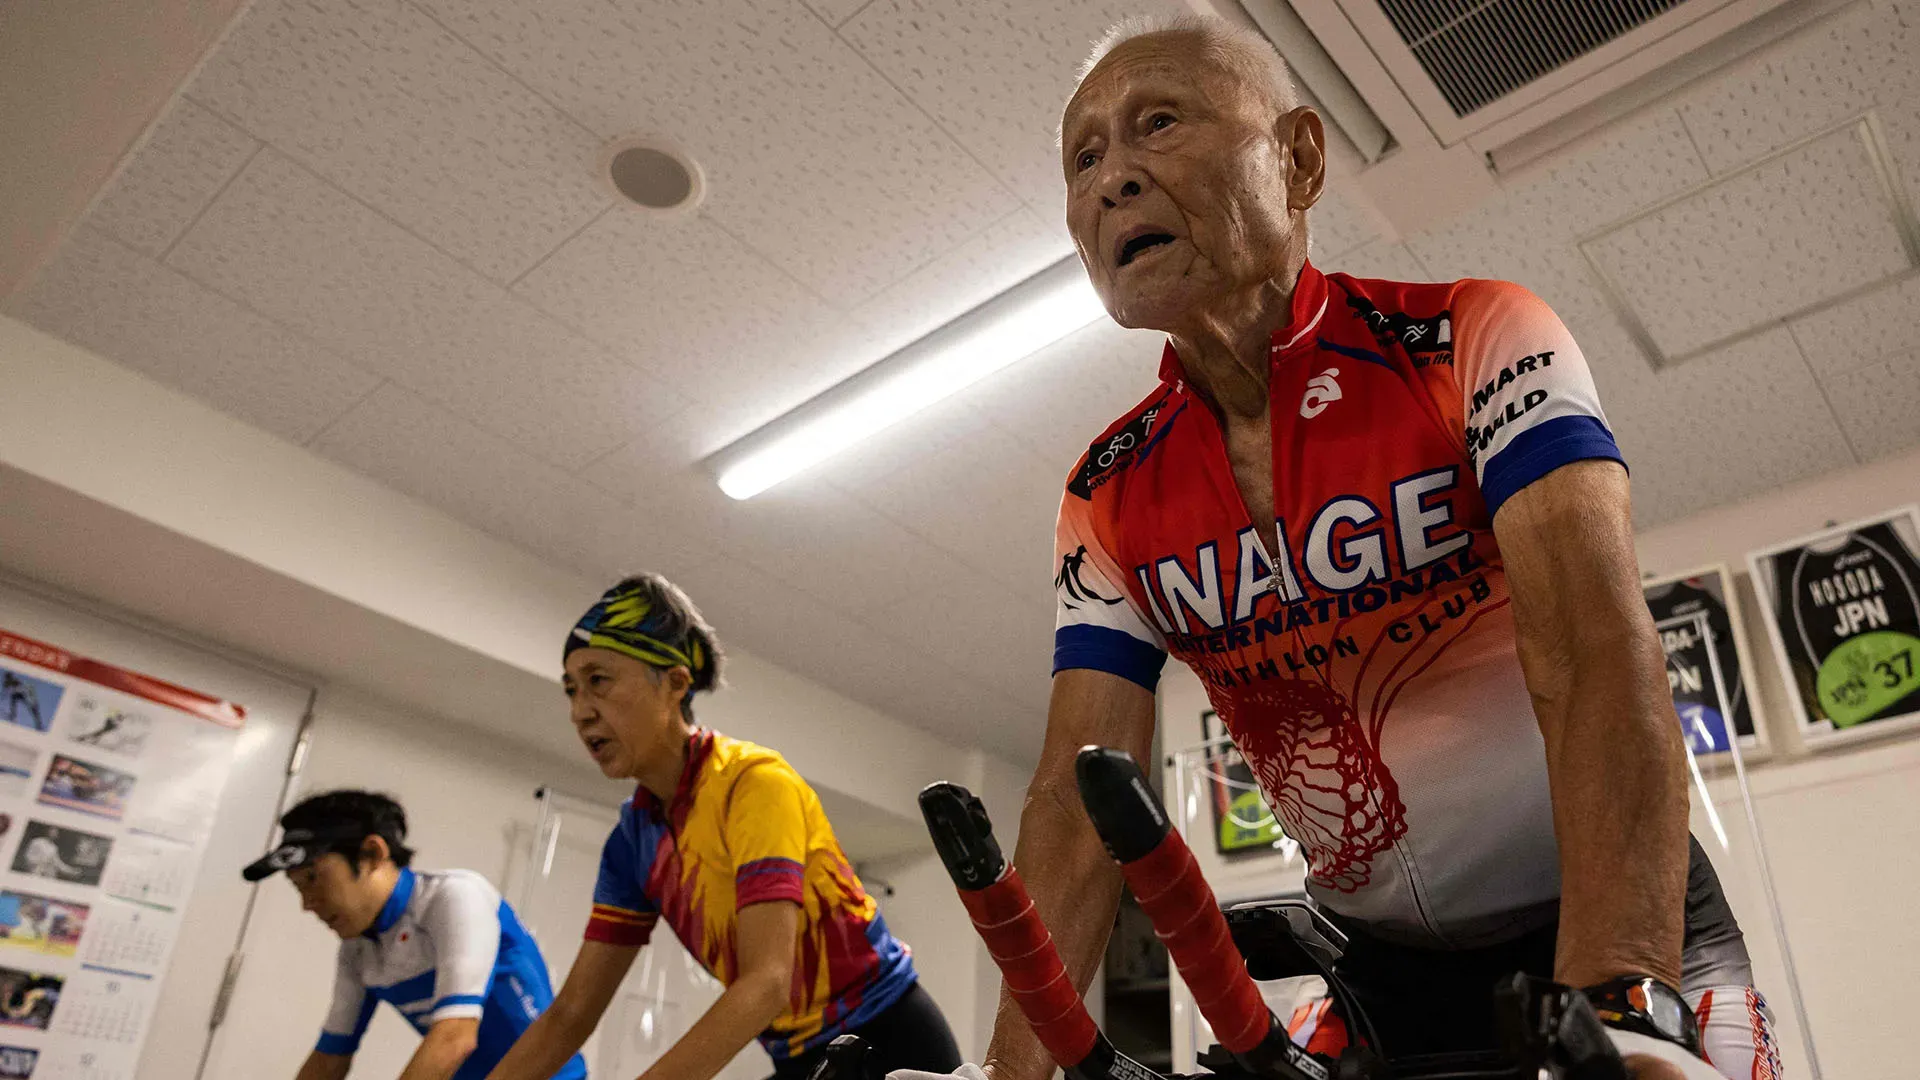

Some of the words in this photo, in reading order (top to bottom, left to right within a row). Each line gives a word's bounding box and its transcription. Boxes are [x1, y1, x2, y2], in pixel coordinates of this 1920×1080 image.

[1470, 351, 1554, 420] MART
[1135, 464, 1475, 637] INAGE
[1387, 577, 1491, 645] CLUB
[1808, 565, 1885, 607] HOSODA
[1834, 596, 1889, 637] JPN
[1873, 647, 1913, 689] 37
